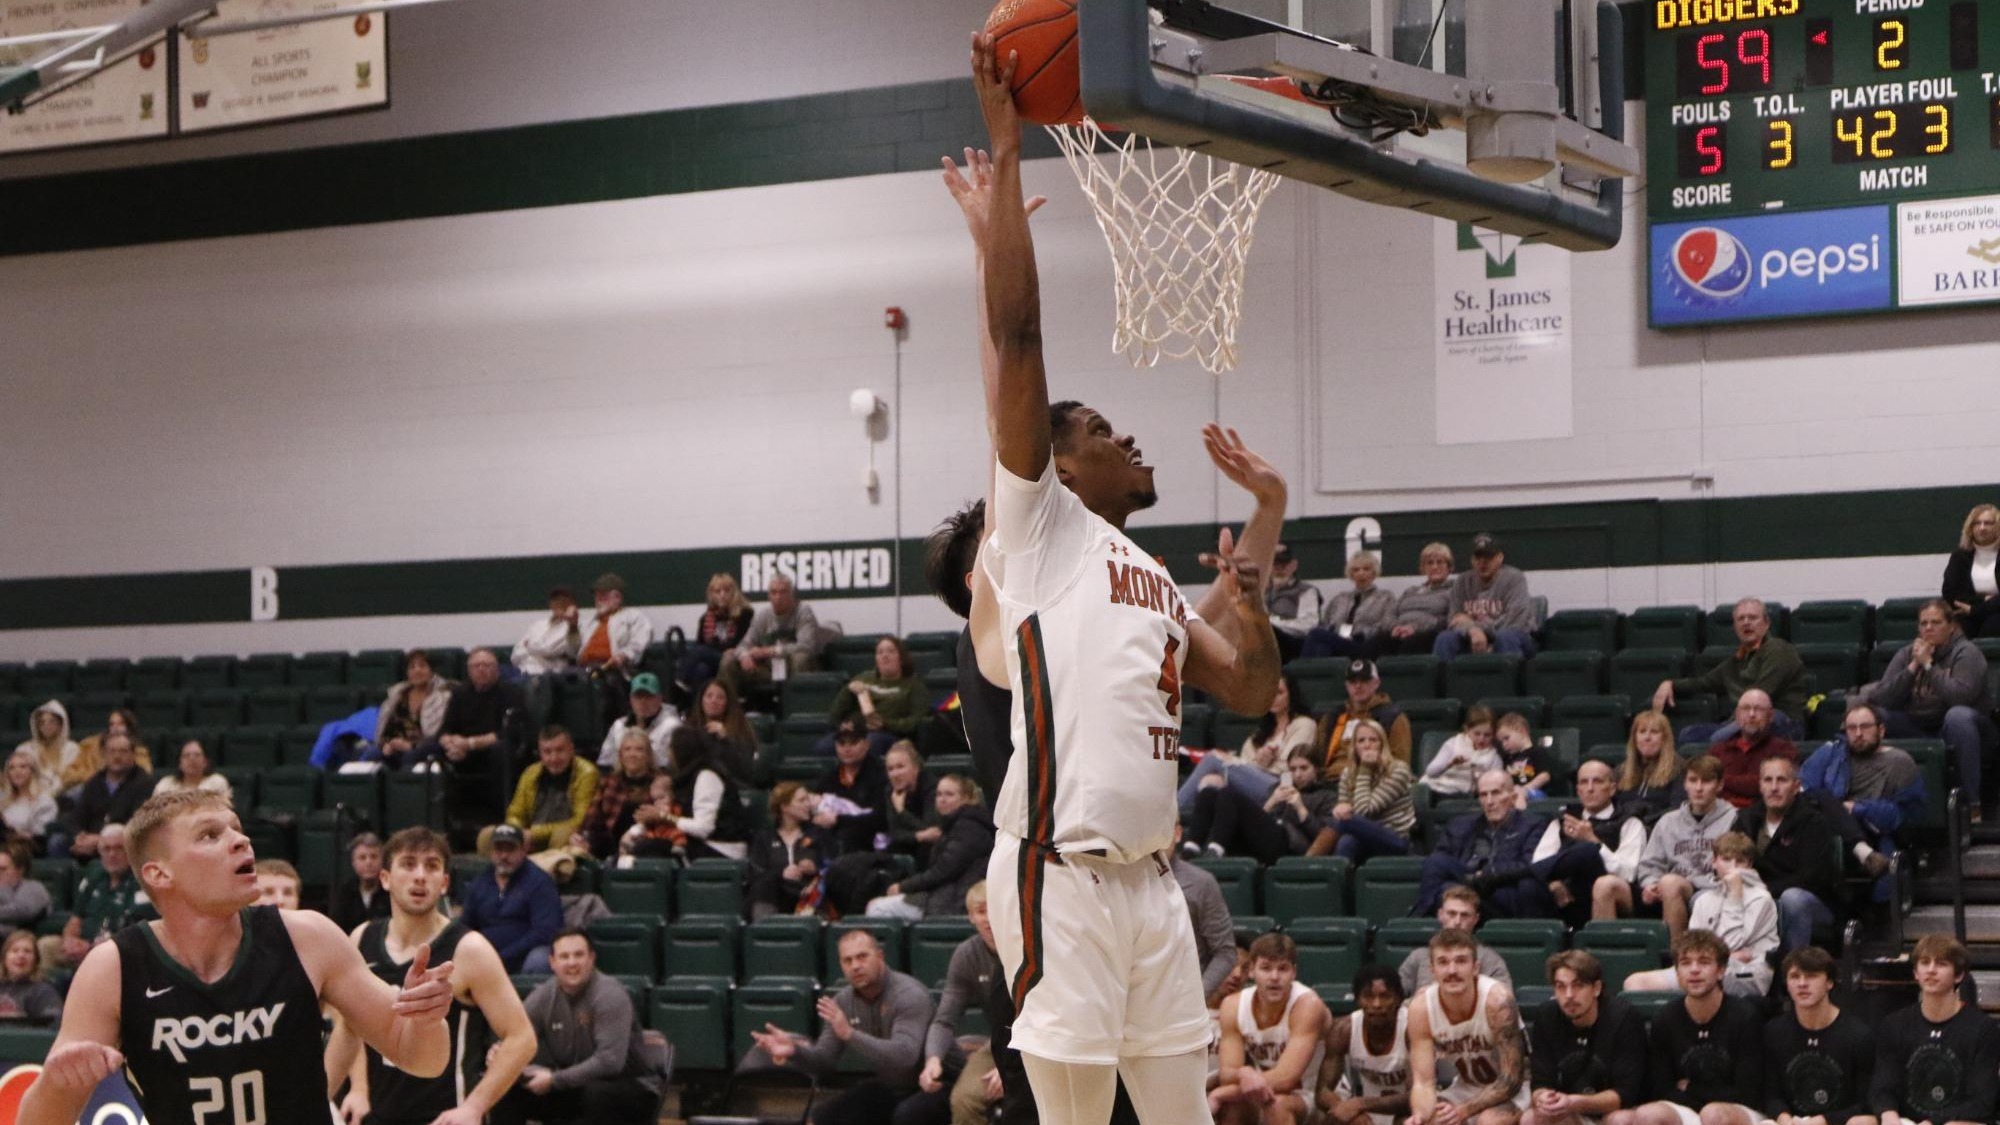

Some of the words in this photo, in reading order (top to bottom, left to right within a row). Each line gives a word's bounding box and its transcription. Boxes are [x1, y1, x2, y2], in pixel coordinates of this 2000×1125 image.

[1657, 0, 1798, 29] DIGGERS
[1856, 0, 1924, 14] PERIOD
[1878, 20, 1904, 69] 2
[251, 68, 308, 86] CHAMPION
[1697, 29, 1770, 94] 59
[1754, 94, 1805, 117] T.O.L.
[1831, 82, 1904, 110] PLAYER
[1908, 77, 1958, 102] FOUL
[1672, 101, 1731, 125] FOULS
[1770, 120, 1791, 168] 3
[1837, 110, 1896, 158] 42
[1925, 104, 1948, 153] 3
[1696, 126, 1722, 175] 5
[1860, 165, 1927, 191] MATCH
[1672, 183, 1732, 208] SCORE
[1907, 211, 1921, 221] Be
[1914, 224, 1926, 235] BE
[1929, 222, 1953, 234] SAFE
[1957, 220, 1975, 232] ON
[1761, 234, 1879, 289] pepsi
[1454, 290, 1480, 311] St.
[1485, 288, 1551, 313] James
[1446, 313, 1562, 338] Healthcare
[741, 548, 891, 592] RESERVED
[251, 567, 279, 621] B
[152, 1002, 285, 1063] ROCKY
[189, 1069, 267, 1125] 20
